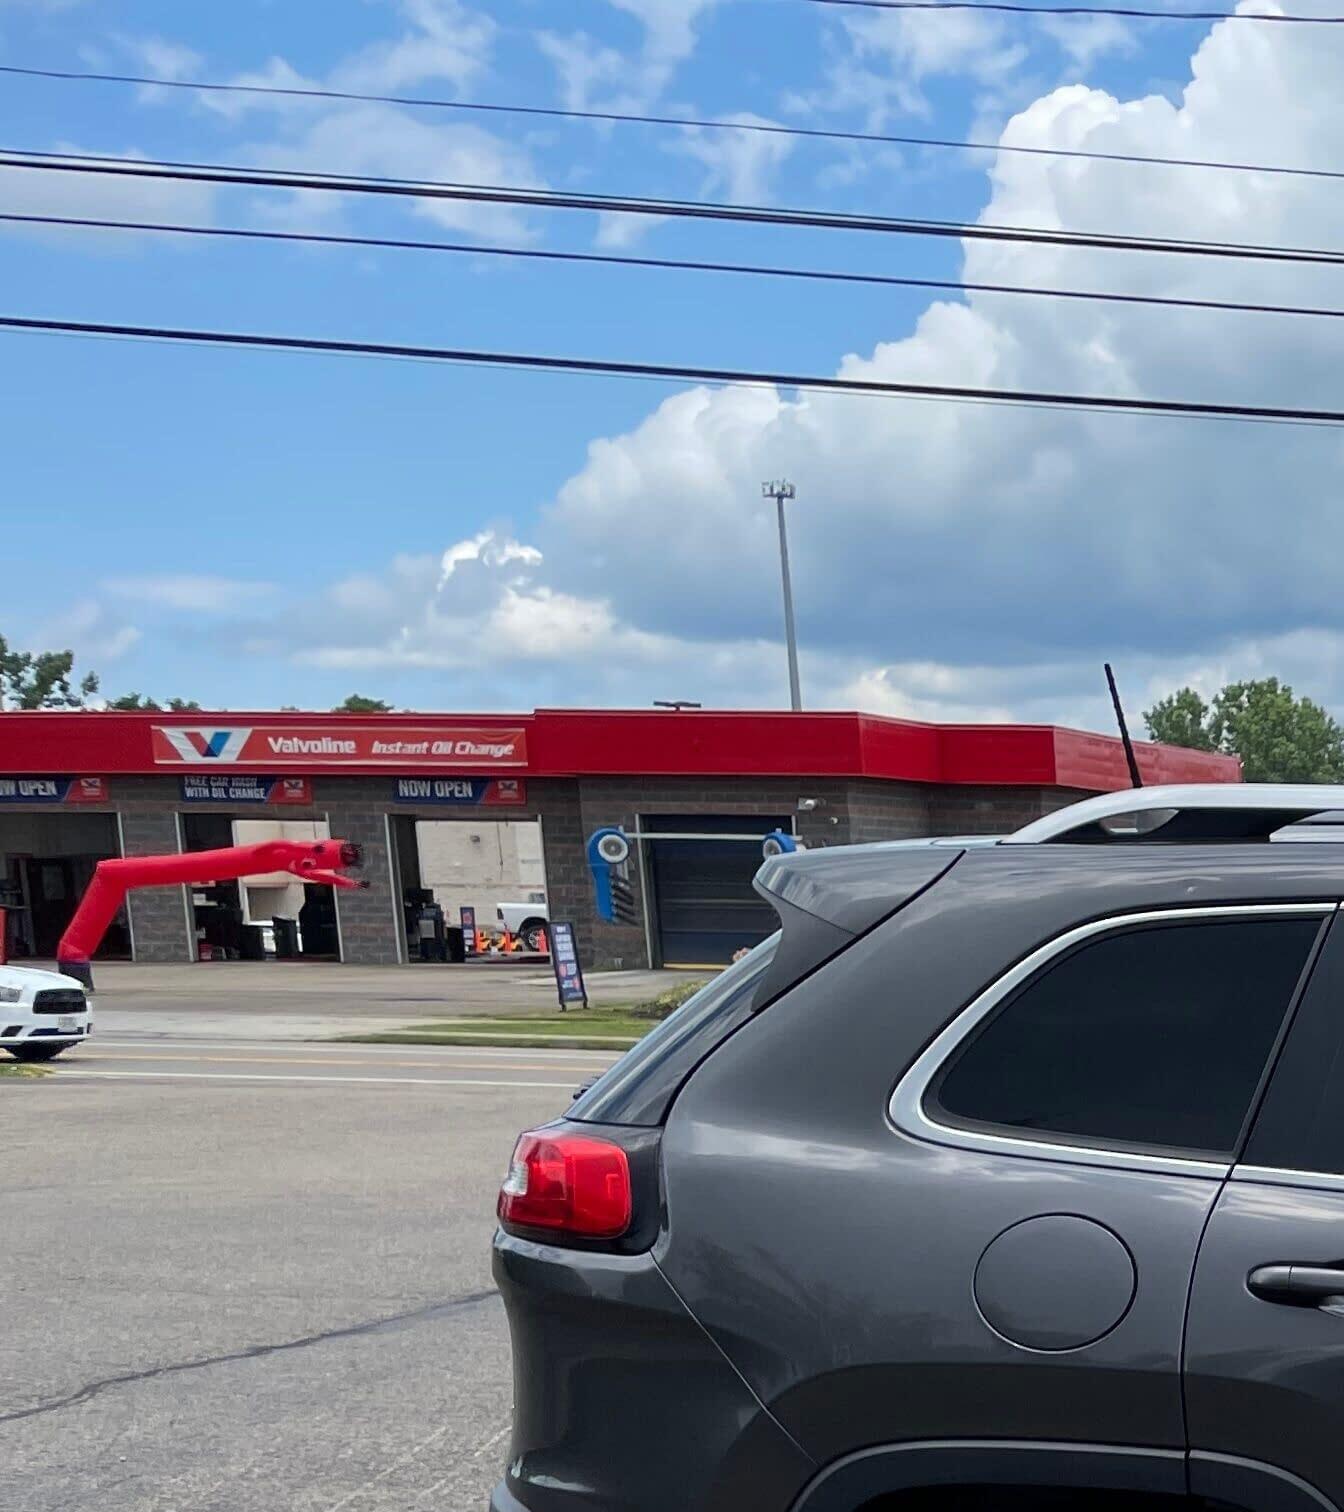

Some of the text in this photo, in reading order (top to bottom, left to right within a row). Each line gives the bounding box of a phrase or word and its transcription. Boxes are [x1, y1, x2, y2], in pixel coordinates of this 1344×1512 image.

[267, 736, 515, 757] Valvoline Instant Oil Change
[18, 780, 57, 796] OPEN
[185, 787, 267, 799] WITH OIL CHANGE
[399, 779, 473, 798] NOW OPEN
